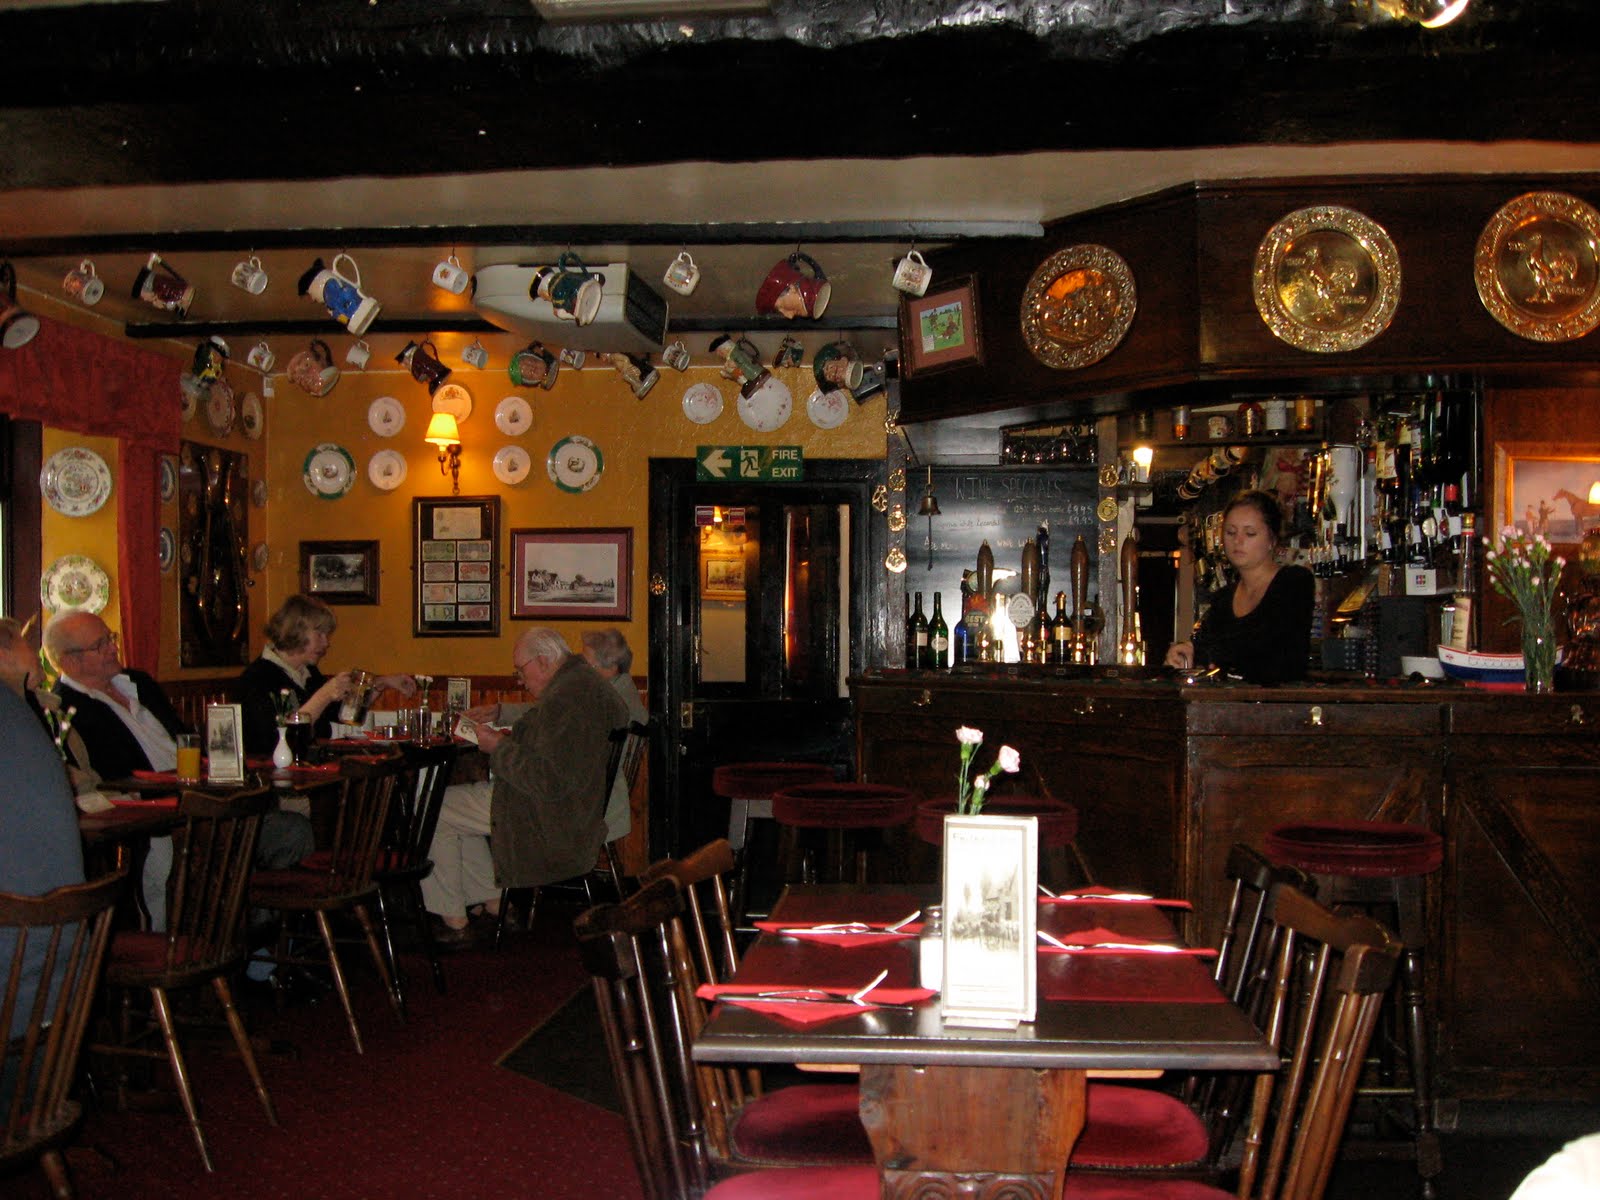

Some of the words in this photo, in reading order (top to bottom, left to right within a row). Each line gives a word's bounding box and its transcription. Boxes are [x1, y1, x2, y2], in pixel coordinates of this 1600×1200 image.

[772, 450, 798, 460] FIRE
[772, 468, 798, 477] EXIT
[956, 477, 992, 500] WINE
[1001, 477, 1063, 499] SPECIALS
